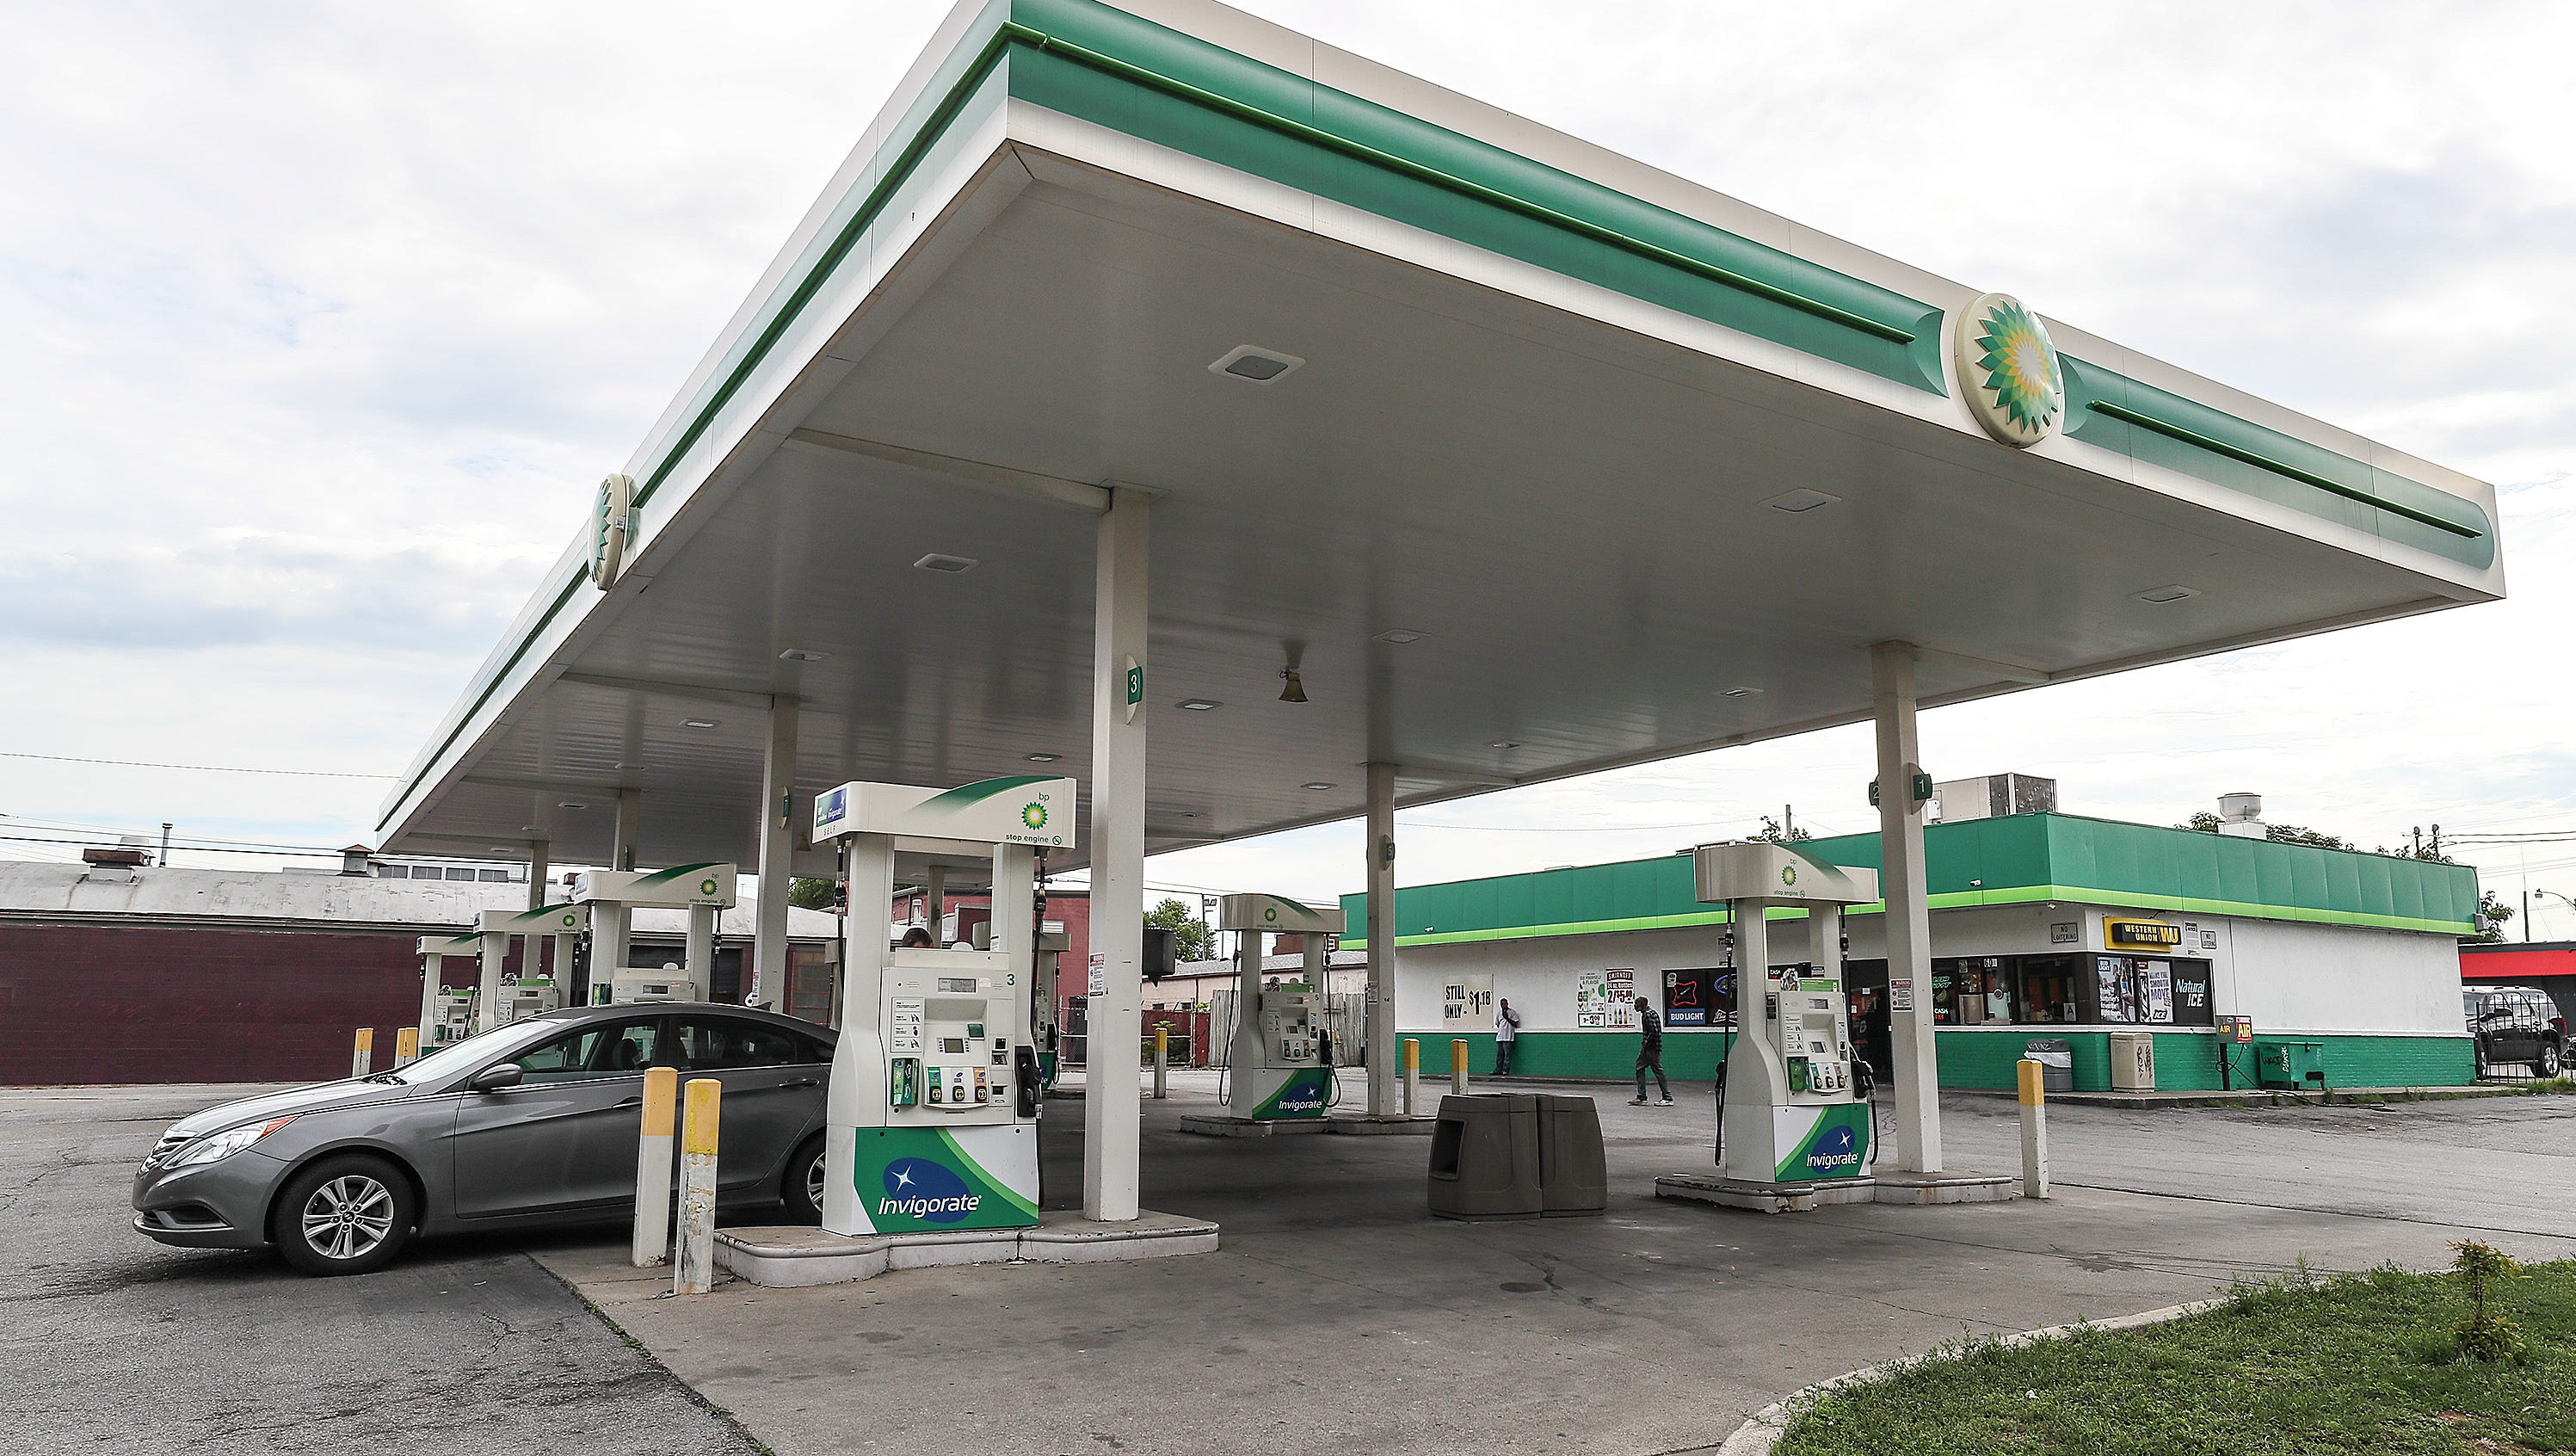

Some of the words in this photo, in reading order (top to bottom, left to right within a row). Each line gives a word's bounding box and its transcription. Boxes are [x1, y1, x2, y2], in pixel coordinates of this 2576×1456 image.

[1131, 674, 1137, 694] 3
[1872, 785, 1879, 799] 2
[1919, 779, 1925, 793] 1
[1038, 792, 1050, 802] bp
[823, 825, 835, 836] SELF
[2124, 924, 2157, 934] WESTERN
[2135, 933, 2158, 941] UNION
[1007, 973, 1015, 986] 3
[2176, 978, 2205, 993] Natural
[1445, 984, 1465, 1000] STILL
[2151, 988, 2170, 1000] MOVE
[1469, 990, 1491, 1015] $1.18
[2187, 993, 2203, 1007] ICE
[1445, 1003, 1463, 1019] ONLY
[1671, 1012, 1684, 1021] BUD
[1685, 1012, 1704, 1021] LIGHT
[2067, 1005, 2074, 1015] A
[2154, 1010, 2167, 1019] ICE
[2238, 1023, 2252, 1038] AIR
[1279, 1099, 1322, 1112] Invigorate
[1806, 1151, 1858, 1169] Invigorate
[878, 1194, 981, 1218] Invigorate
